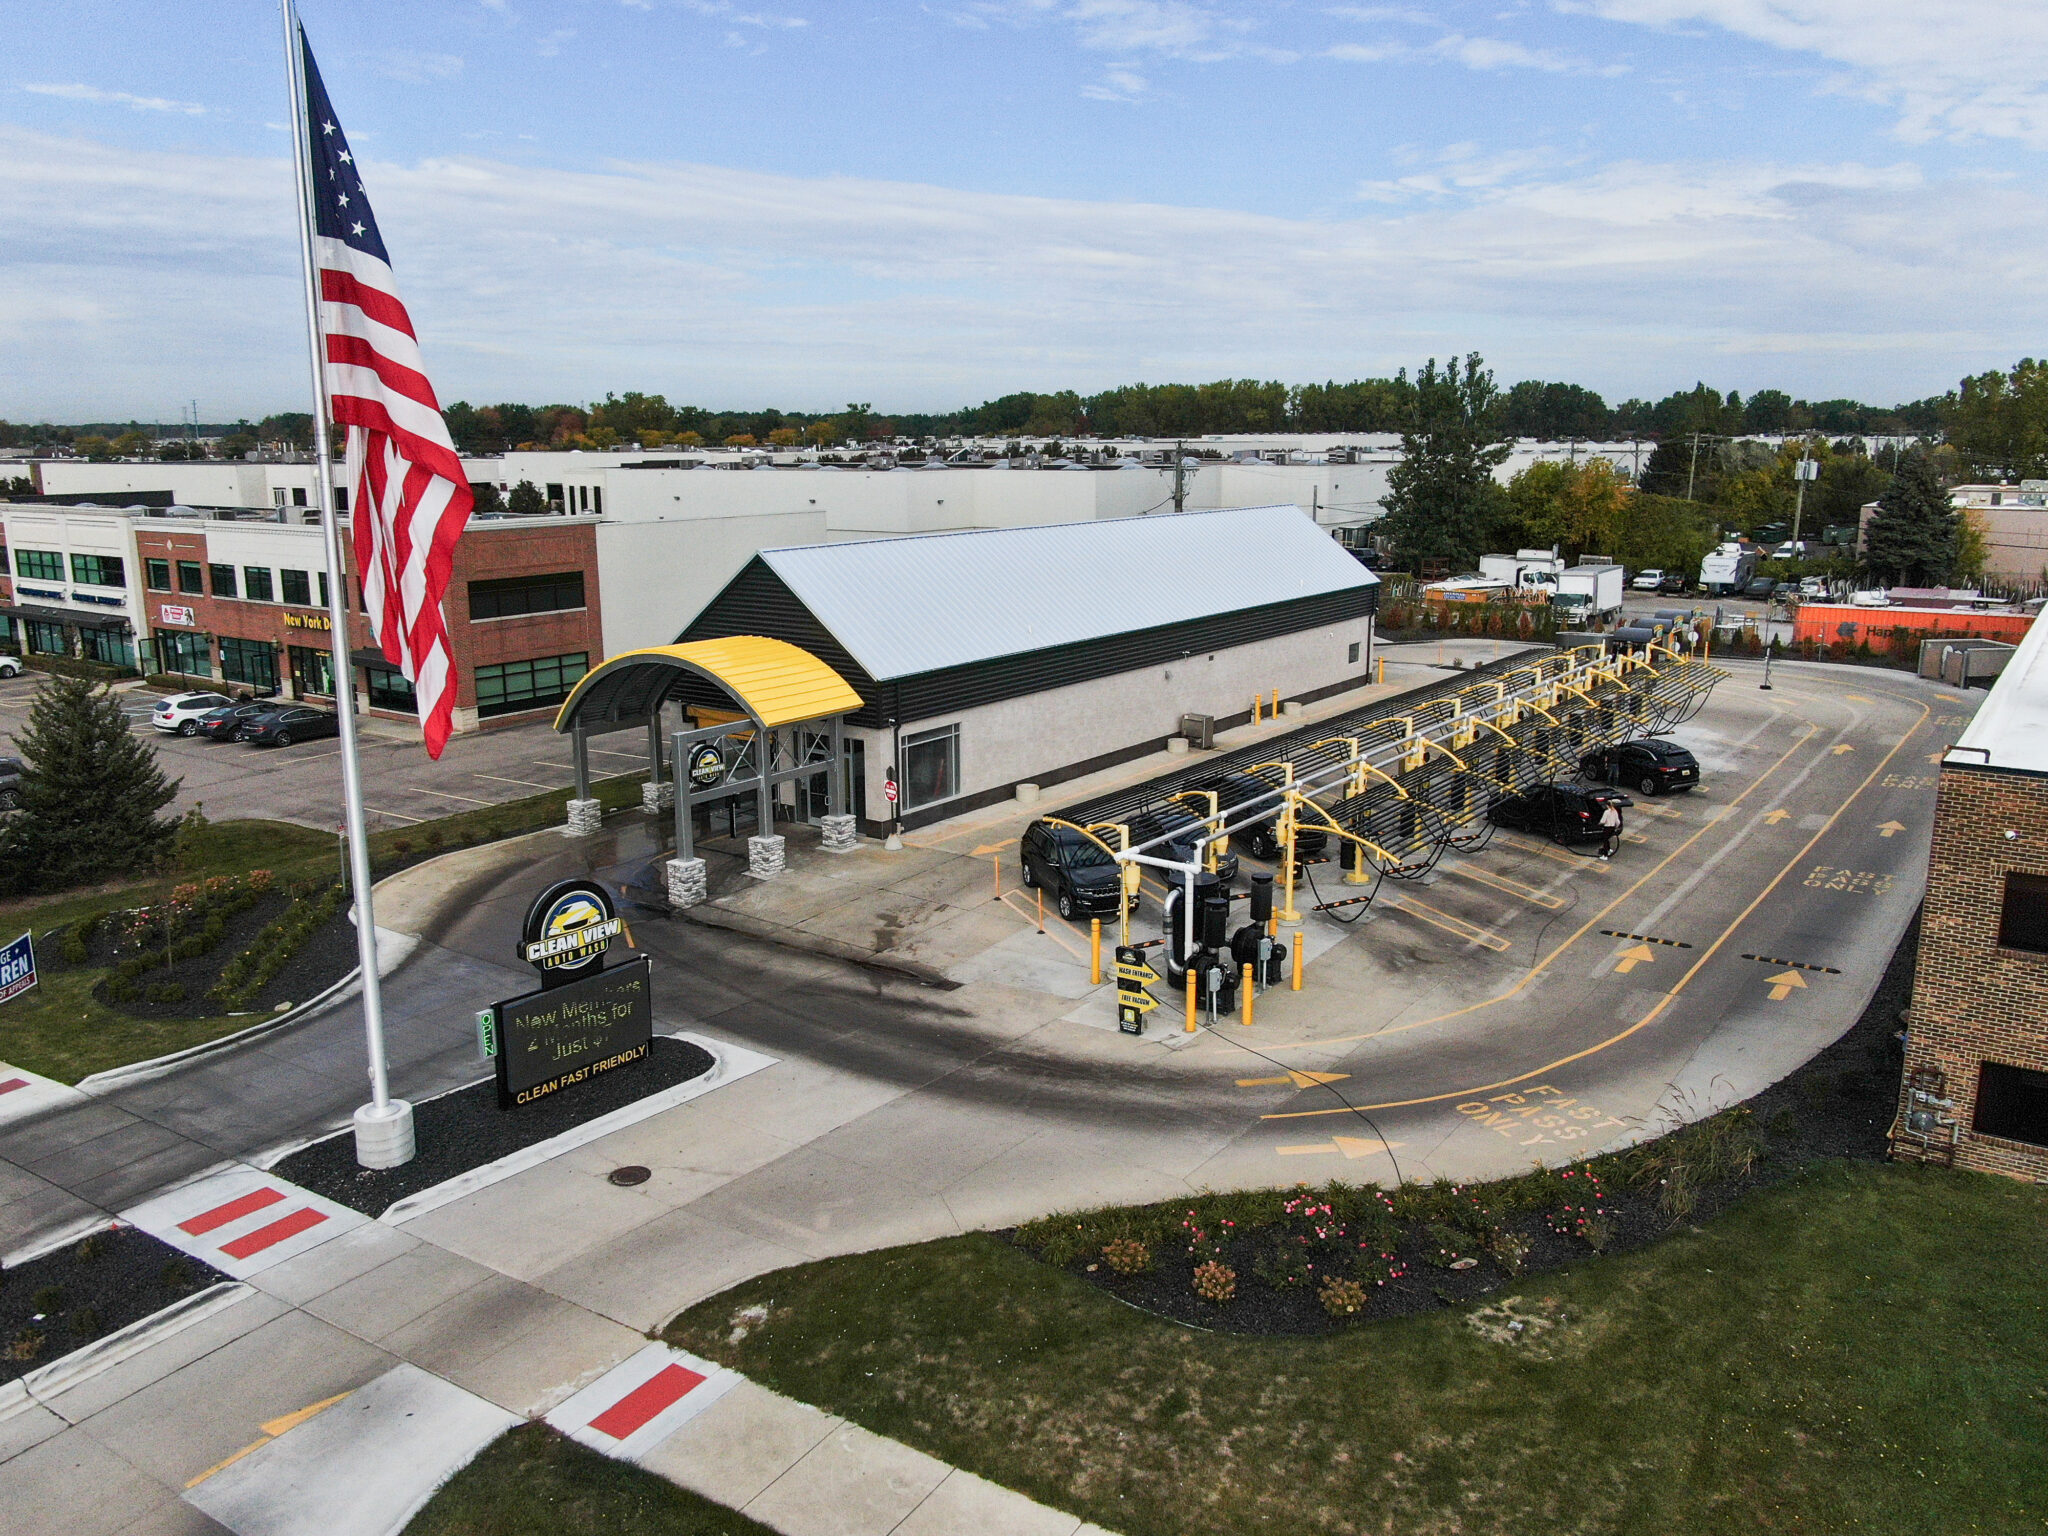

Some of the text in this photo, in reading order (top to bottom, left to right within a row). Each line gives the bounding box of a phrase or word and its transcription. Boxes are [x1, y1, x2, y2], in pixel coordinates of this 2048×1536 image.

[284, 612, 302, 627] New
[303, 614, 323, 630] York
[529, 919, 618, 960] CLEAN VIEW
[547, 940, 605, 967] AUTO WASH
[8, 976, 31, 996] APPEALS
[1132, 969, 1154, 980] ENTRANCE
[612, 1001, 633, 1020] for
[1122, 994, 1150, 1007] FREE VACUUM
[552, 1036, 589, 1061] Just
[517, 1044, 646, 1104] CLEAN FAST FRIENDLY
[1488, 1092, 1588, 1140] PASS
[1523, 1085, 1627, 1127] FAST
[1456, 1101, 1557, 1146] ONLY
